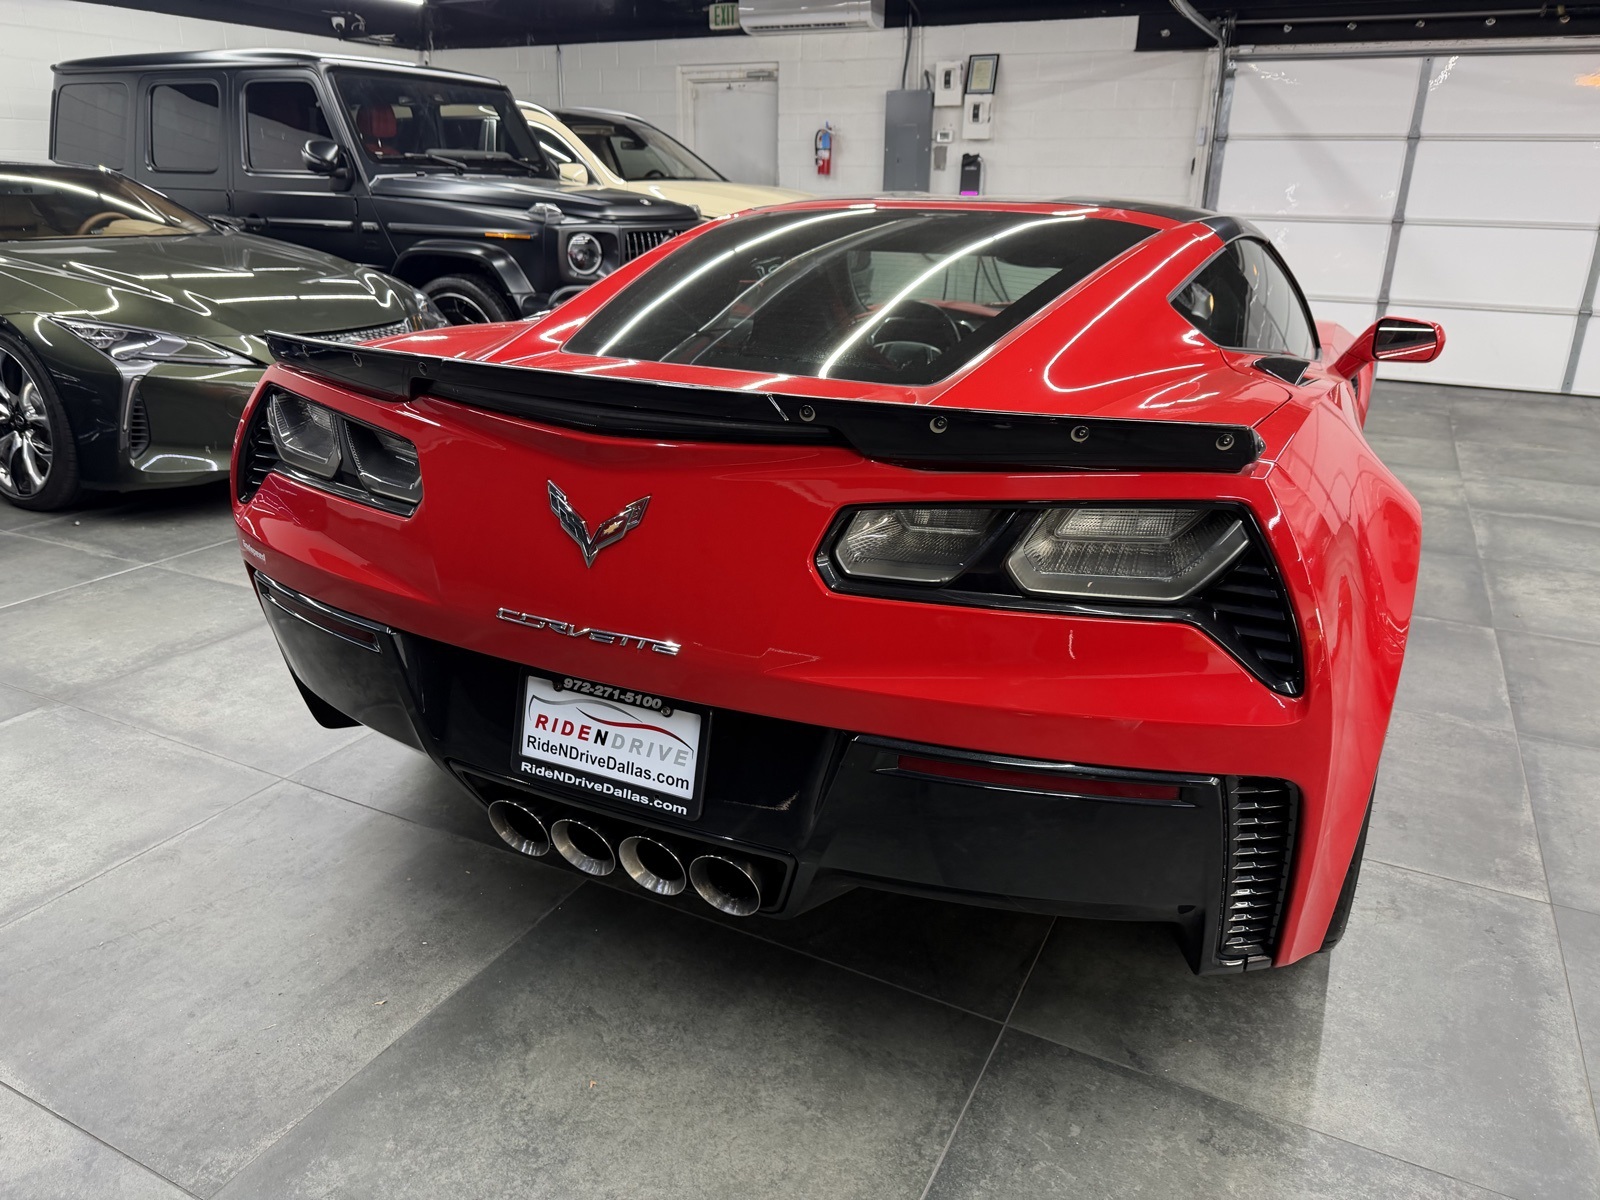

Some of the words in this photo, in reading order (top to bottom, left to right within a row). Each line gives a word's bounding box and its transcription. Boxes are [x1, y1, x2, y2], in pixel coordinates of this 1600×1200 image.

[714, 5, 735, 26] EXIT
[496, 607, 681, 656] CORVETTE
[563, 678, 663, 710] 972-271-5100
[526, 735, 690, 791] RideNDriveDallas.com
[520, 761, 688, 816] RideNDriveDallas.com
